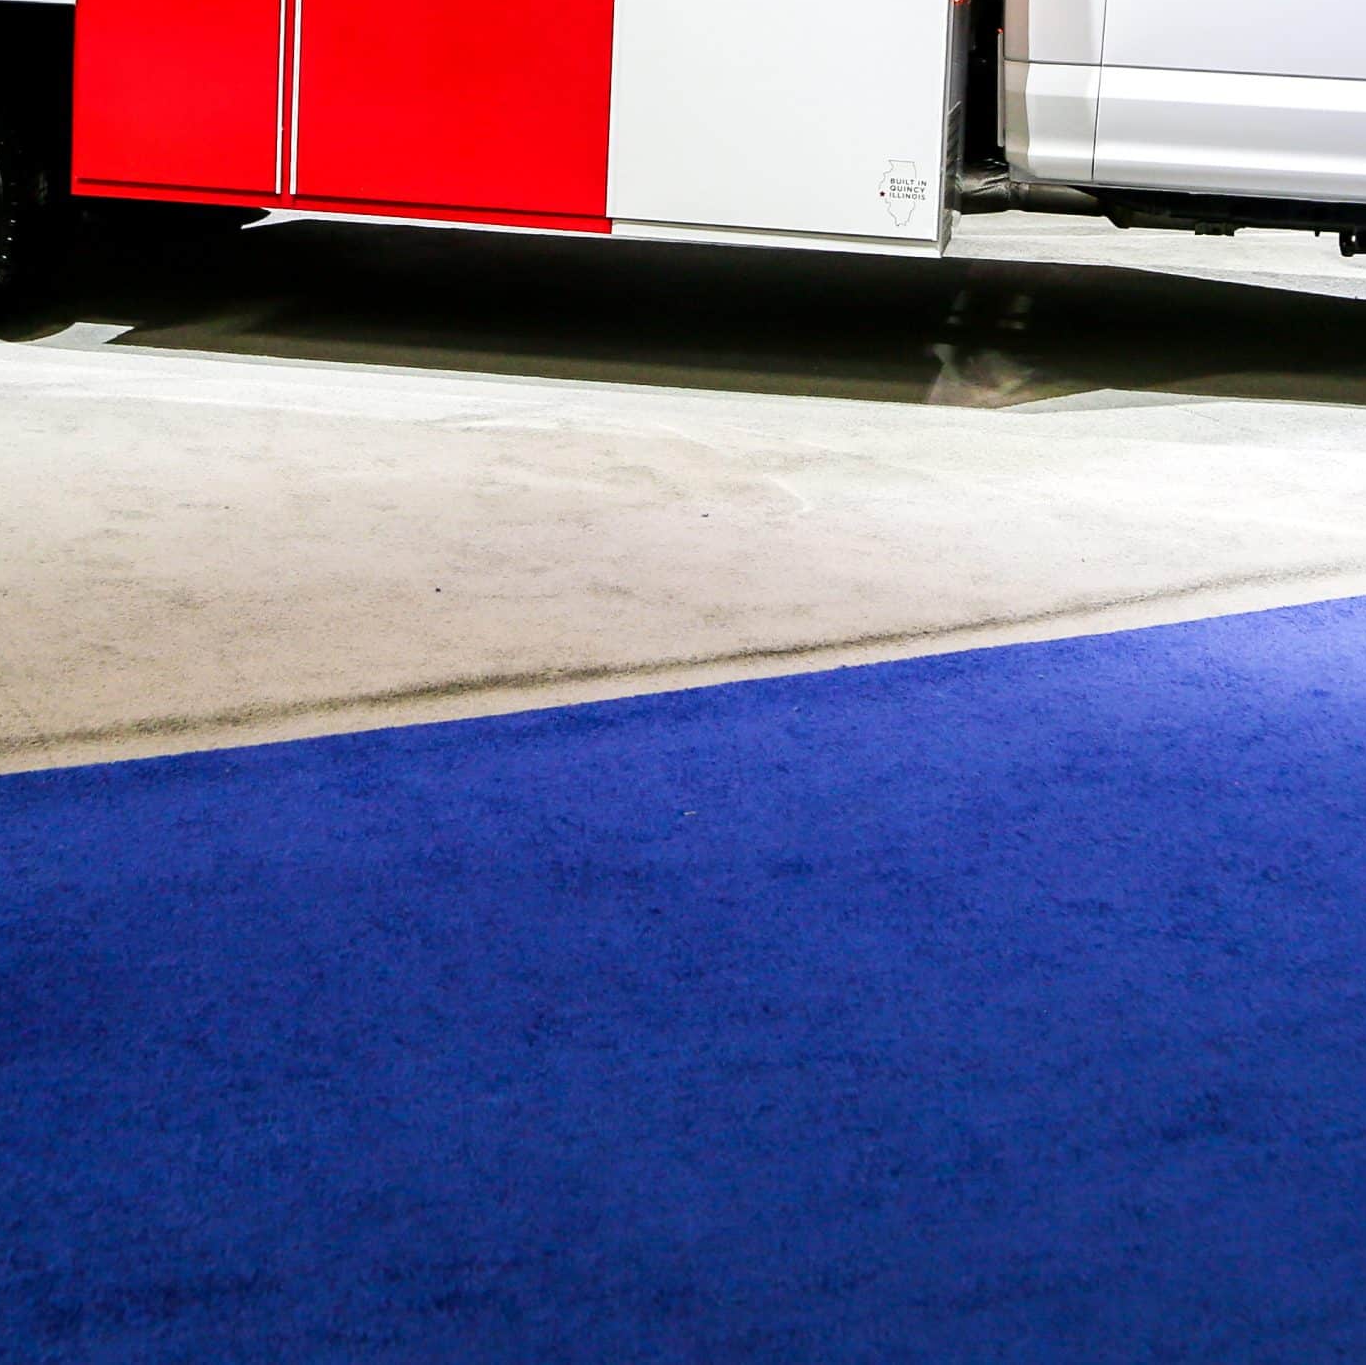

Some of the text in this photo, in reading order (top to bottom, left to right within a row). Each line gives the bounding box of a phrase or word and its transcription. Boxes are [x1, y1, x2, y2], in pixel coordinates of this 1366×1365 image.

[890, 177, 915, 185] BUILT
[889, 185, 926, 193] QUINCY
[889, 192, 926, 200] ILLINOIS
